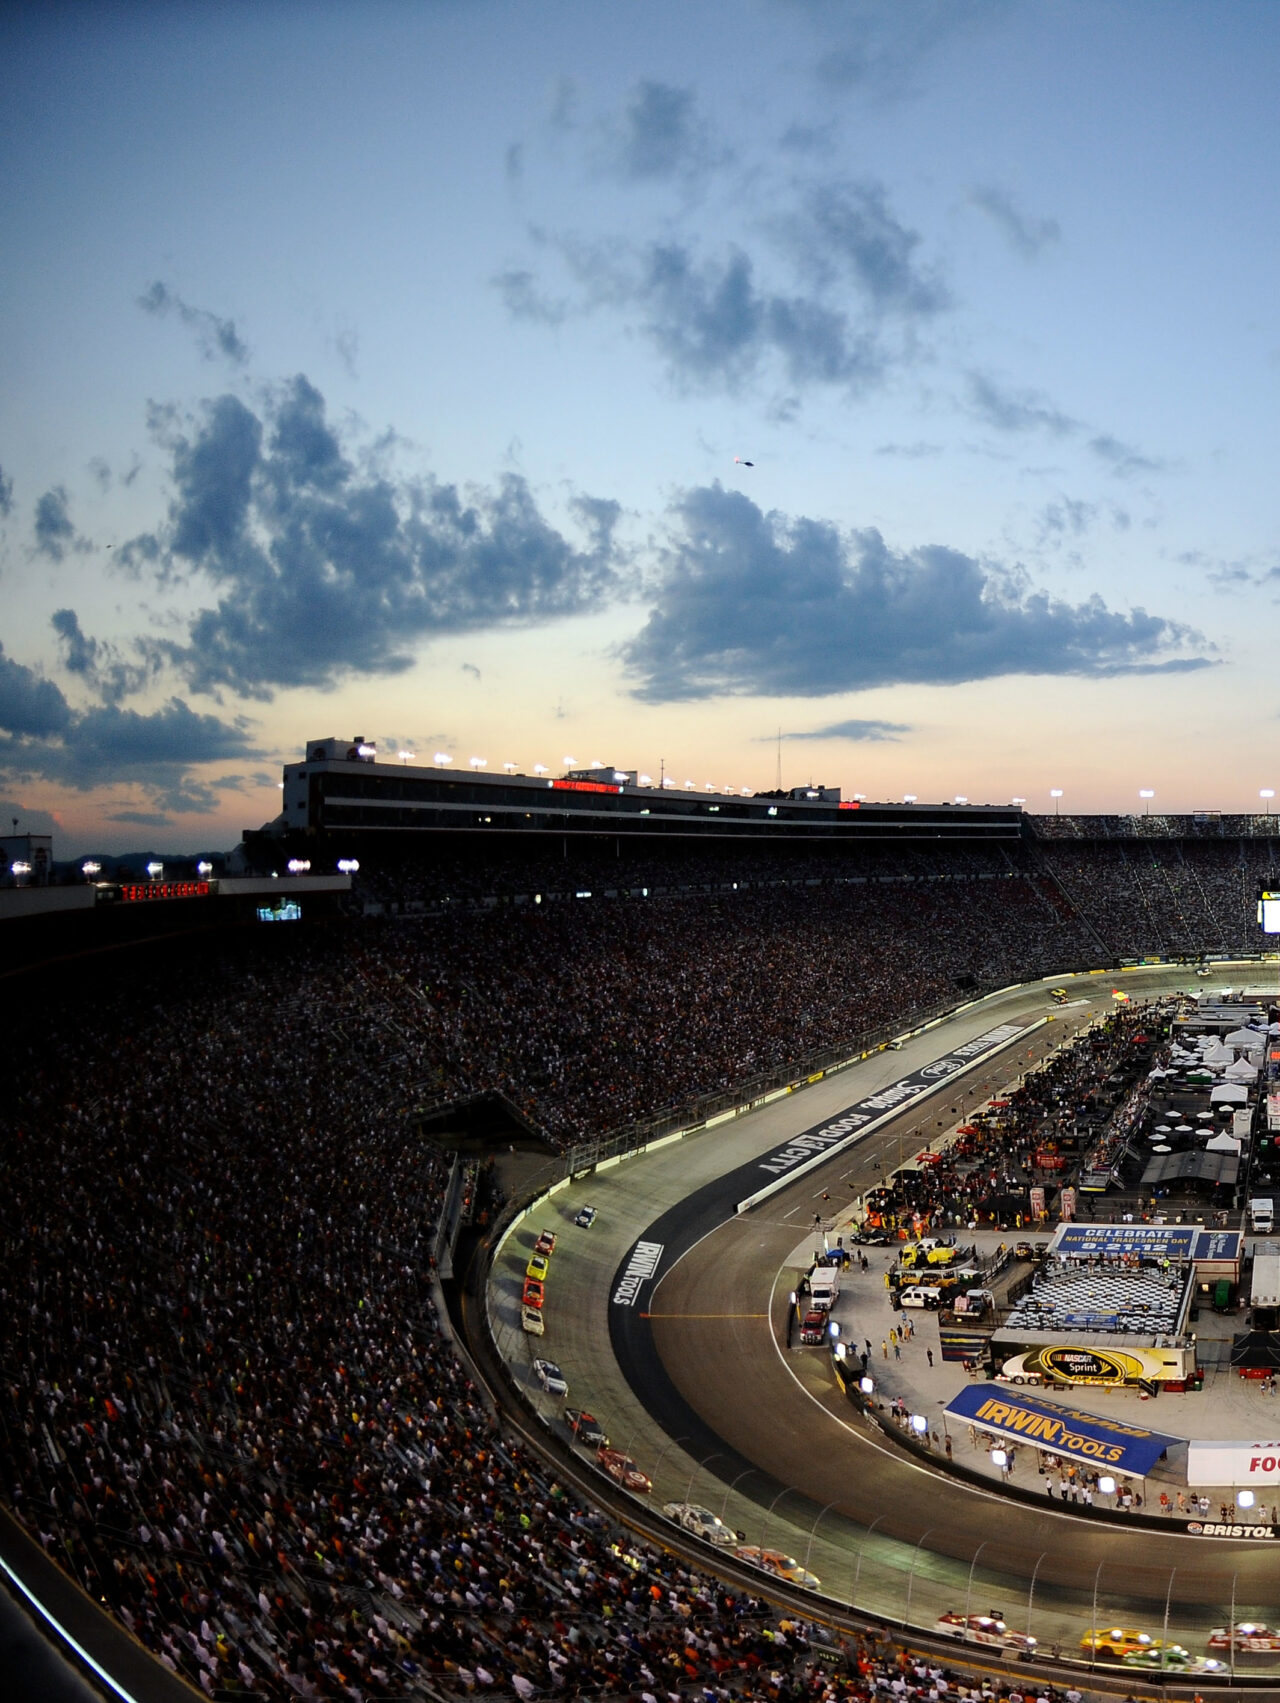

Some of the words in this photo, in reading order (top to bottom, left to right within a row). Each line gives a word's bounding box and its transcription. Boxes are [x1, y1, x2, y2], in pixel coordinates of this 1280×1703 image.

[818, 1113, 872, 1138] FOOD
[758, 1147, 812, 1174] CITY
[1085, 1229, 1174, 1238] CELEBRATE
[1081, 1242, 1168, 1251] 9.21.12
[625, 1241, 662, 1278] IRWIN
[613, 1276, 640, 1305] TOOLS
[1069, 1362, 1098, 1373] Sprint
[976, 1400, 1062, 1441] IRWIN
[1057, 1432, 1123, 1461] TOOLS
[1202, 1523, 1275, 1538] BRISTOL
